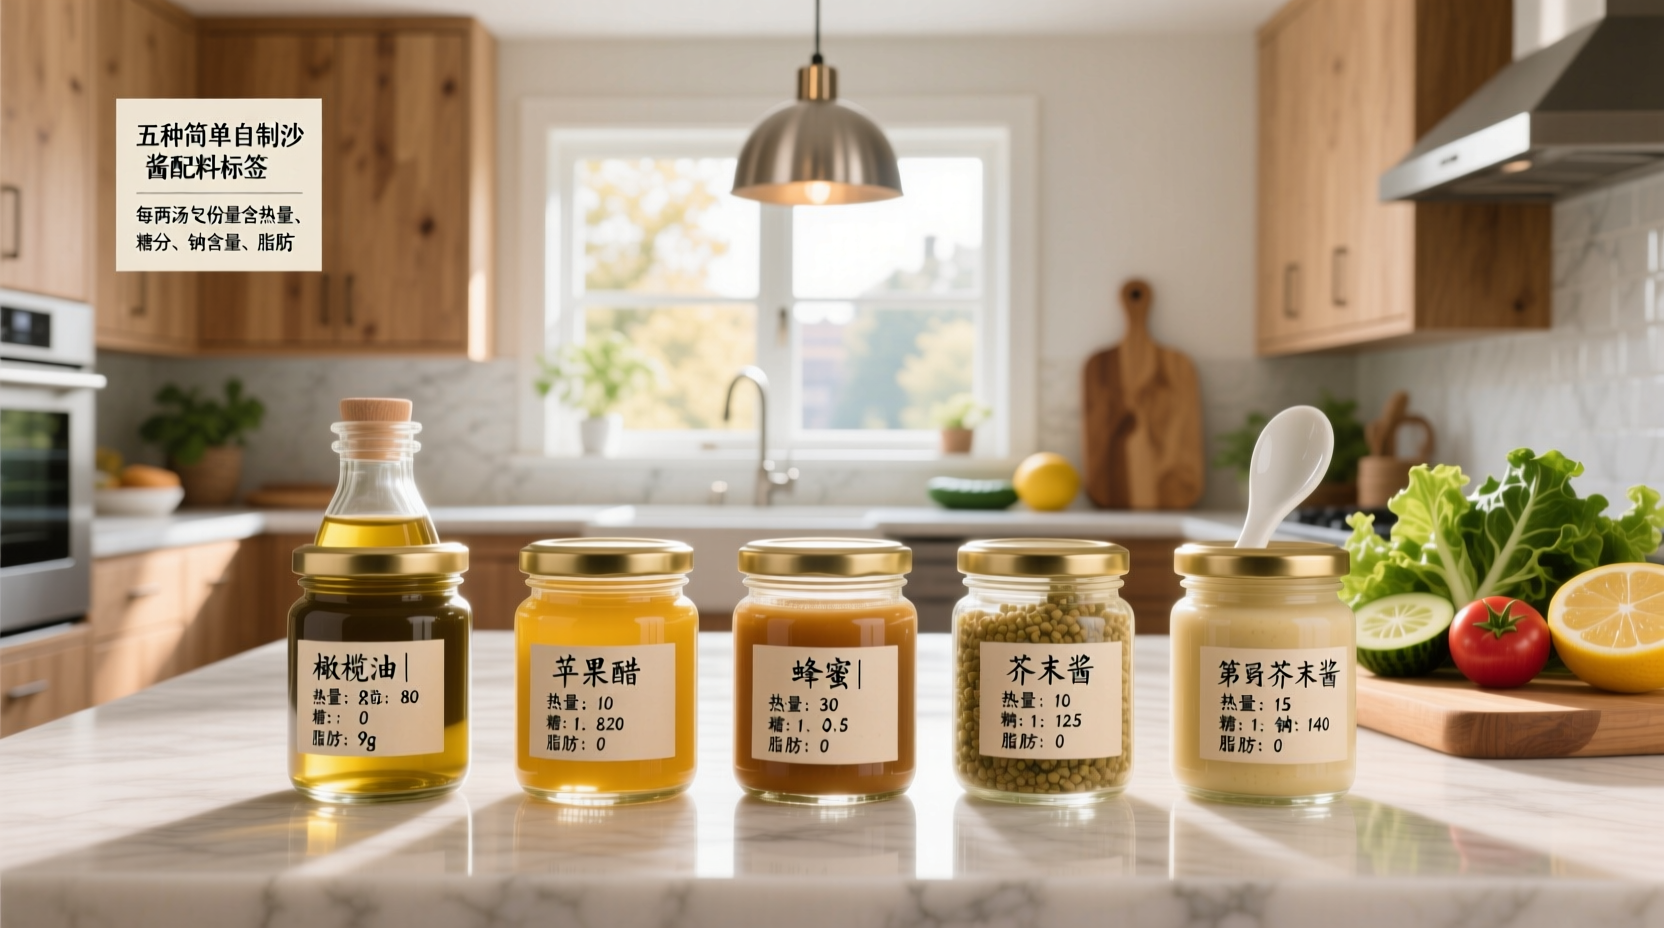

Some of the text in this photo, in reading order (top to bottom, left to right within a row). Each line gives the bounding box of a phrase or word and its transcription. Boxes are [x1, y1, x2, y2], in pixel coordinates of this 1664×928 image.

[552, 654, 641, 689] 苹果醋
[1006, 654, 1094, 686] 芥末酱
[400, 690, 420, 704] 80
[597, 696, 614, 711] 10
[819, 697, 839, 712] 30
[1055, 693, 1071, 708] 10
[1275, 697, 1292, 712] 15
[596, 716, 625, 731] 820
[821, 717, 849, 733] 0.5
[1056, 713, 1082, 728] 125
[1308, 716, 1330, 732] 140
[357, 730, 377, 752] 9g
